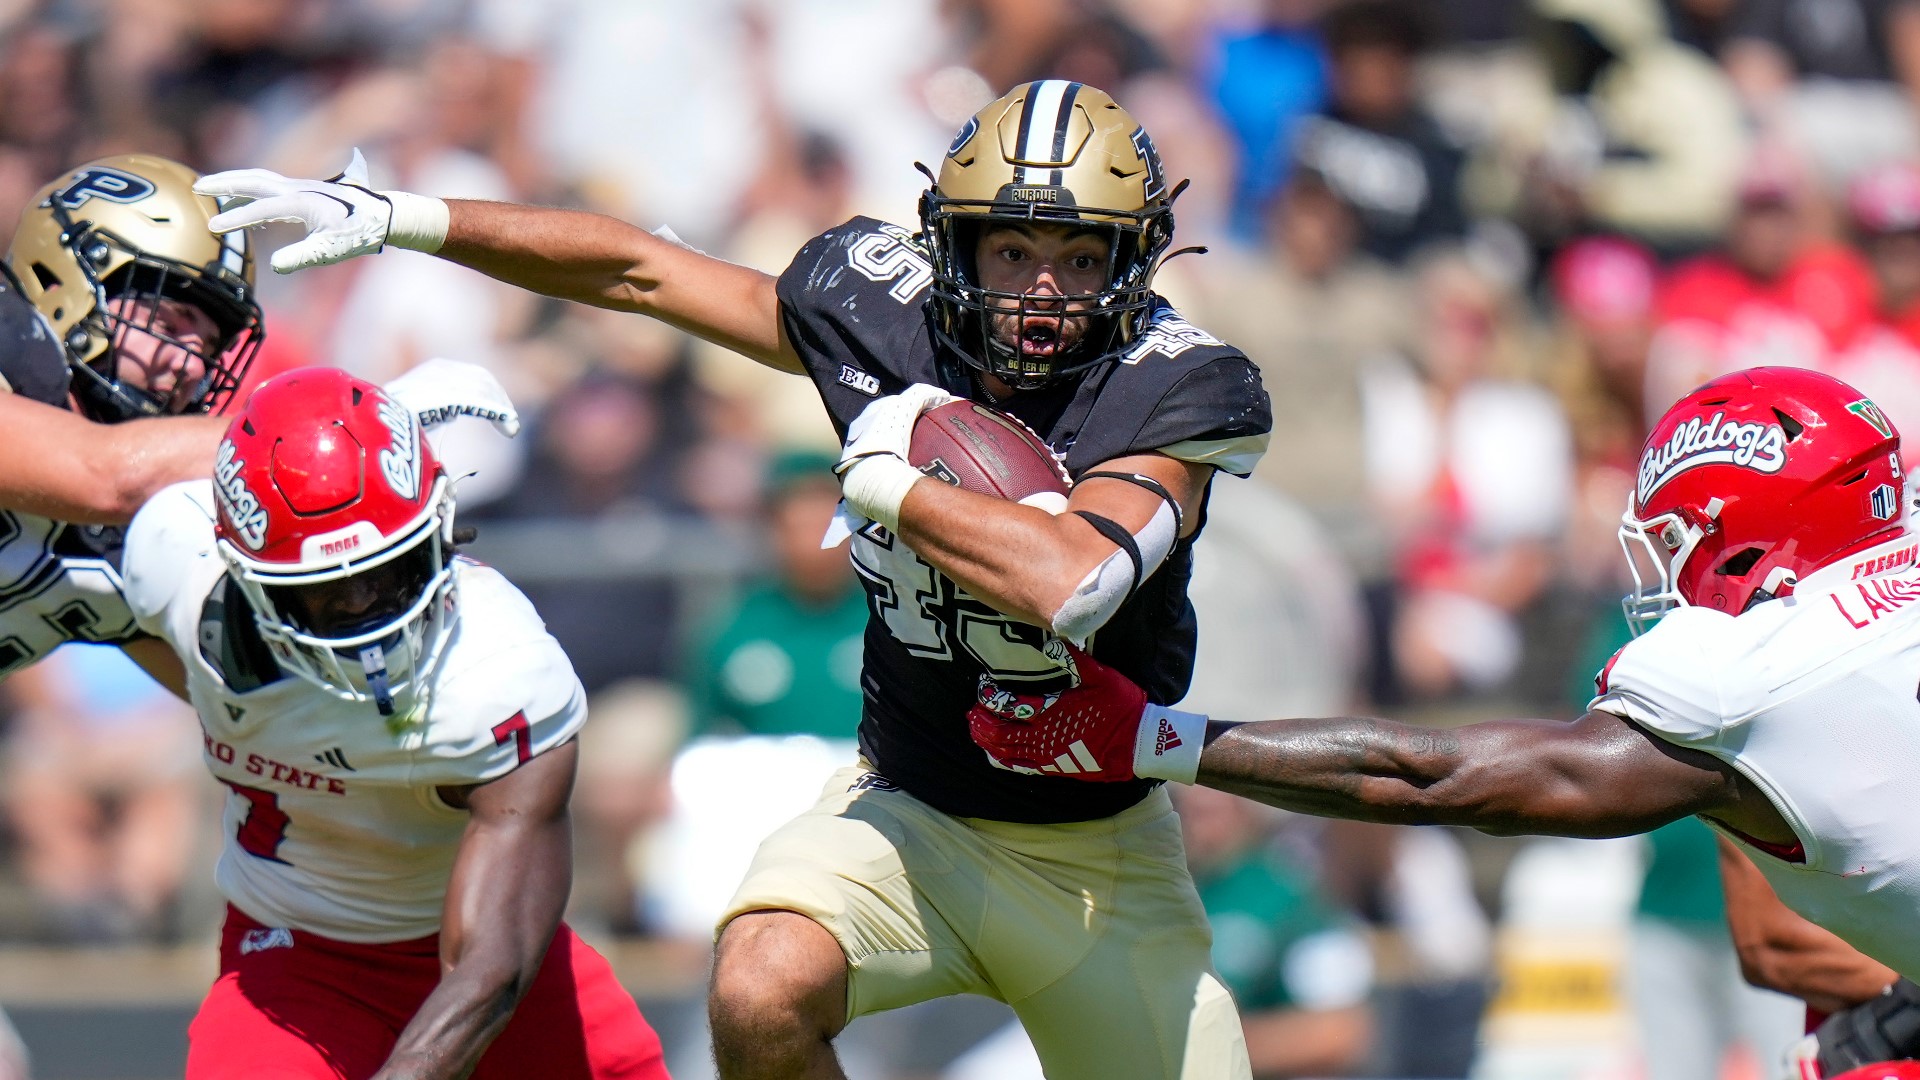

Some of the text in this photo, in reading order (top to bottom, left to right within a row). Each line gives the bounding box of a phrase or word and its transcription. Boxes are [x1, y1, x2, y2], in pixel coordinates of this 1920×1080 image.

[39, 165, 157, 209] P
[1011, 188, 1057, 202] PURDUE
[1007, 358, 1037, 373] BOLER
[1637, 410, 1786, 507] Bulldogs
[491, 709, 534, 766] 7
[1154, 718, 1168, 756] adidas
[245, 752, 346, 796] STATE
